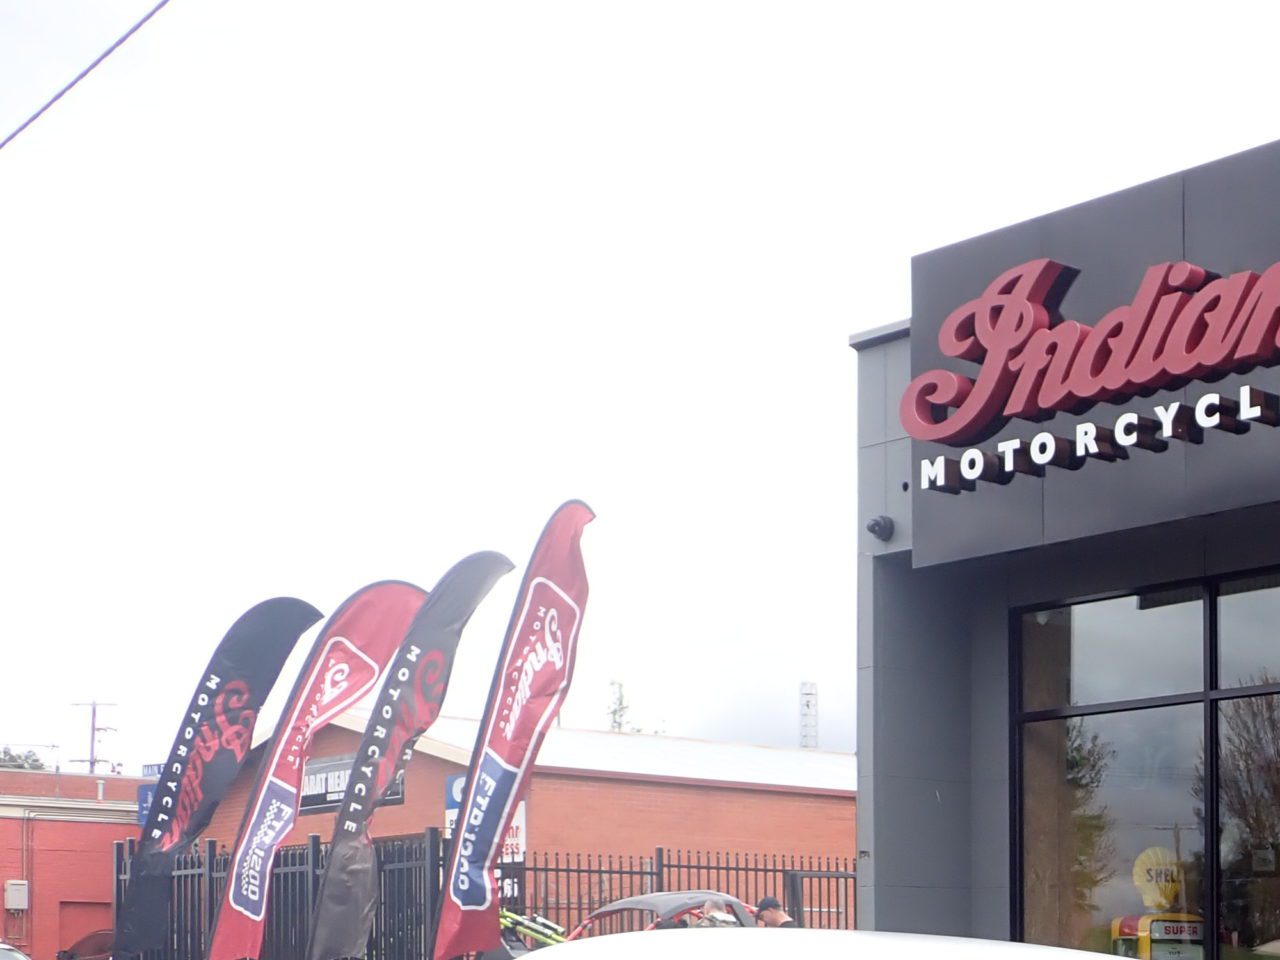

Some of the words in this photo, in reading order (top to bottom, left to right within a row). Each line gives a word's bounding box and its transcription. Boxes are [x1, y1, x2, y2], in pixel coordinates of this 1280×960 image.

[151, 674, 221, 840] MOTORCYCLE
[344, 645, 422, 833] MOTORCYCLE
[1163, 925, 1198, 936] SUPER
